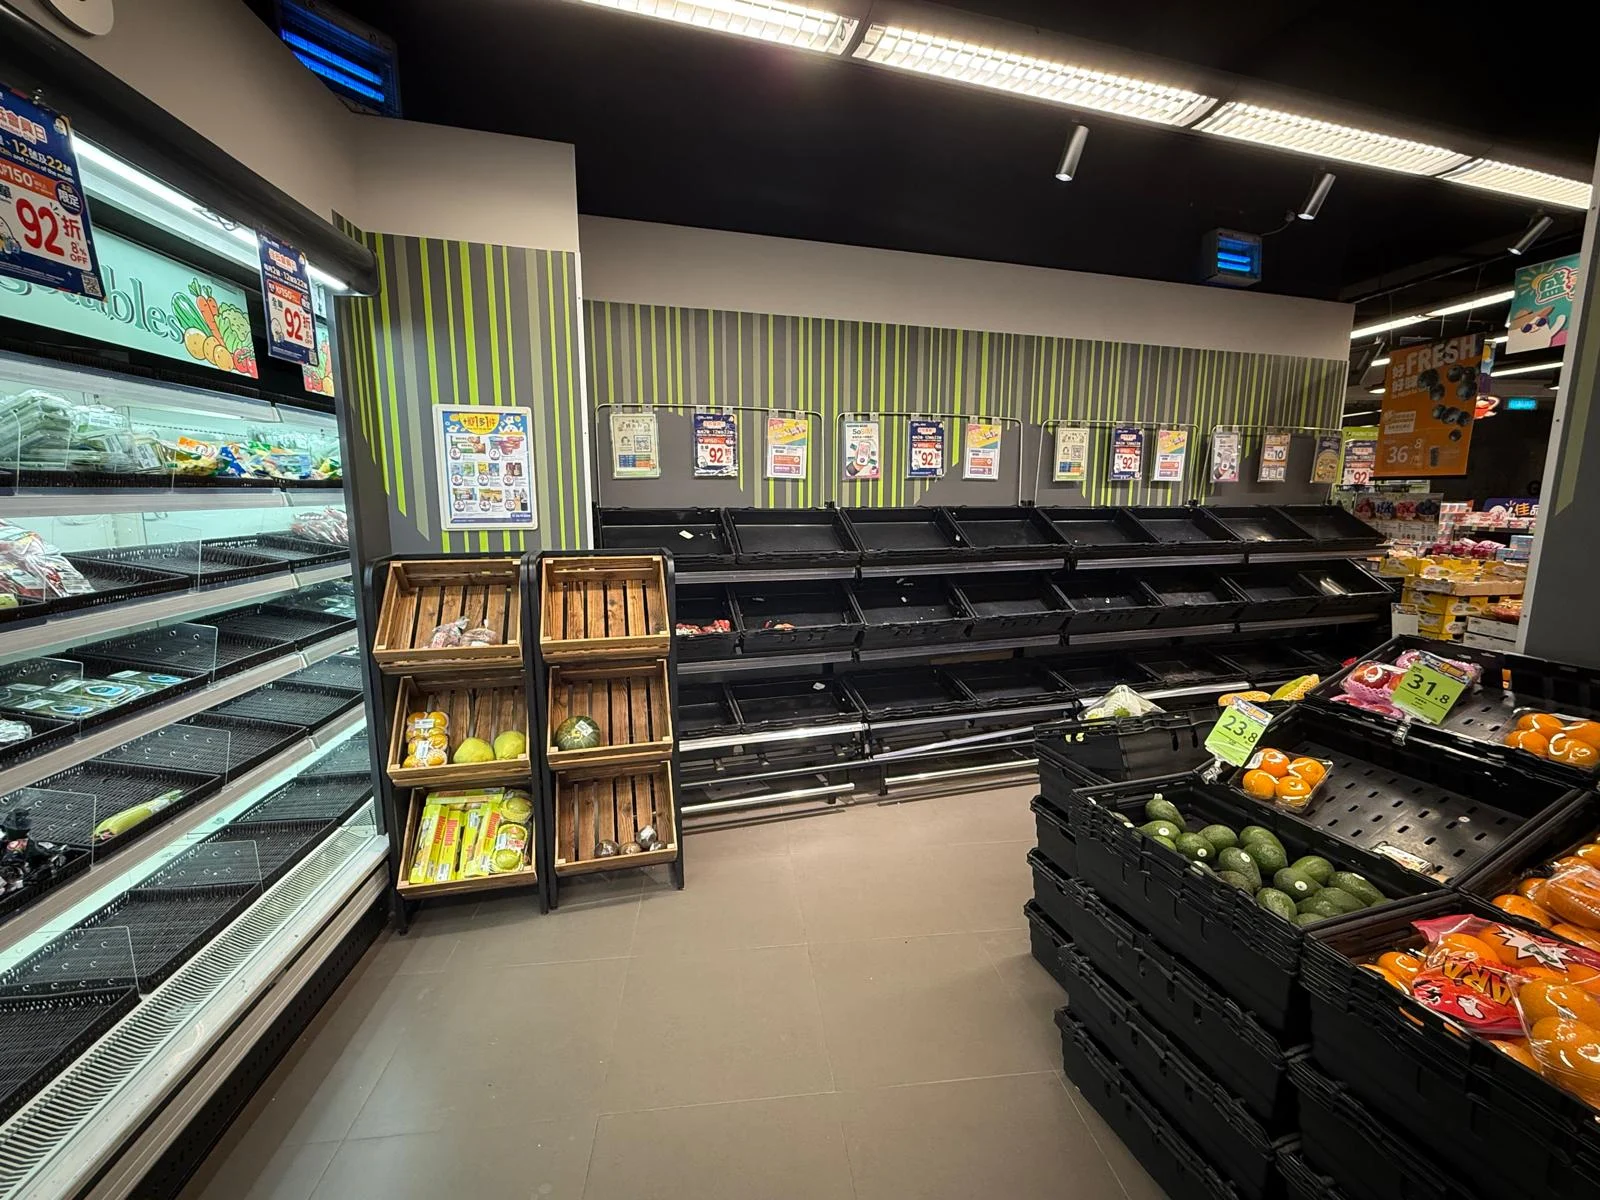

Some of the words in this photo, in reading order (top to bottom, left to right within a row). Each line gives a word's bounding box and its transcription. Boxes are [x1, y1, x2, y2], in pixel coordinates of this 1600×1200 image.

[16, 197, 64, 257] 92
[61, 214, 81, 241] 折
[70, 254, 87, 265] OFF
[284, 307, 303, 341] 92
[1406, 334, 1477, 376] FRESH
[709, 448, 723, 463] 92
[922, 452, 933, 466] 92
[1122, 456, 1133, 469] 92
[1386, 446, 1409, 464] 36
[1353, 471, 1367, 484] 92
[1407, 673, 1450, 704] 31.8
[1222, 715, 1258, 743] 23.8
